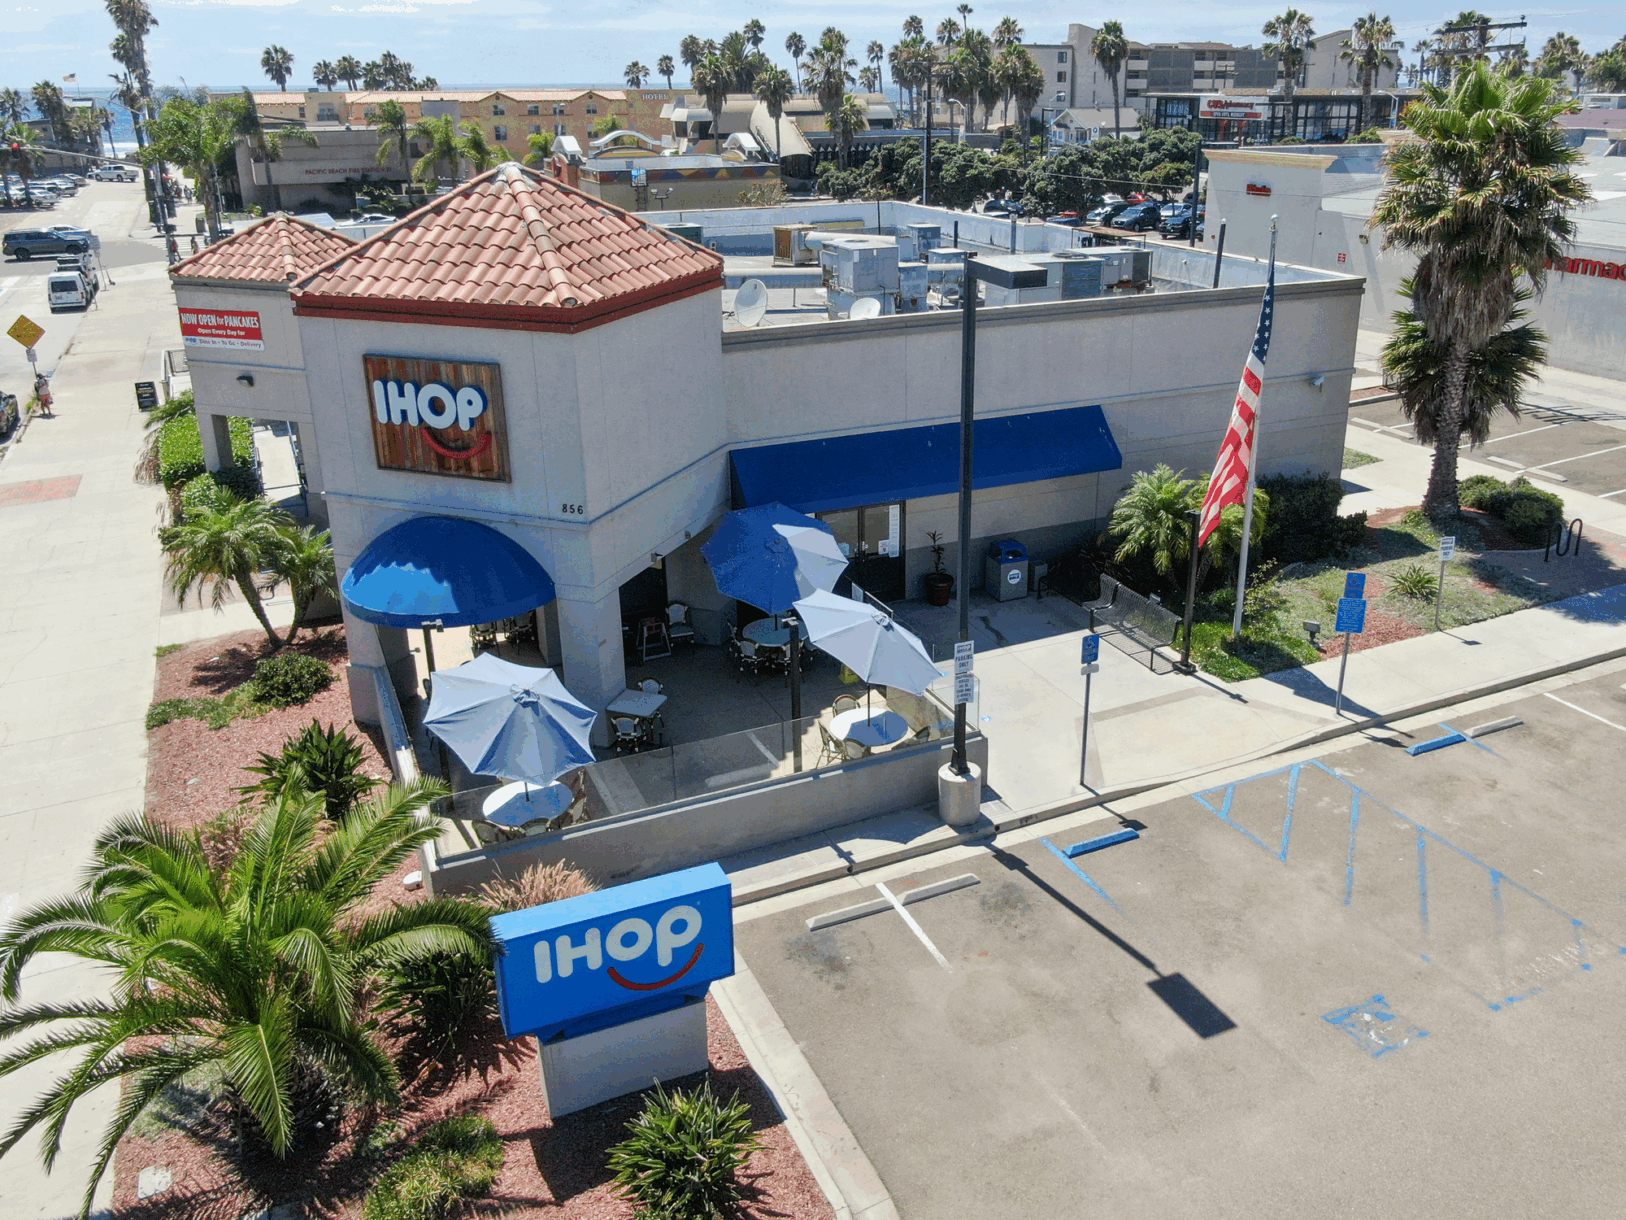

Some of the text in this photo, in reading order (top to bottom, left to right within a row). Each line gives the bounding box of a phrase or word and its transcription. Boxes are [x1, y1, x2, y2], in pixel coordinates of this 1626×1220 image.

[642, 93, 669, 101] HOTEL
[181, 313, 197, 325] NOW
[198, 314, 217, 326] OPEN
[224, 316, 259, 328] PANCAKES
[373, 380, 487, 432] IHOP
[562, 503, 584, 515] 856
[534, 905, 702, 984] IHOP
